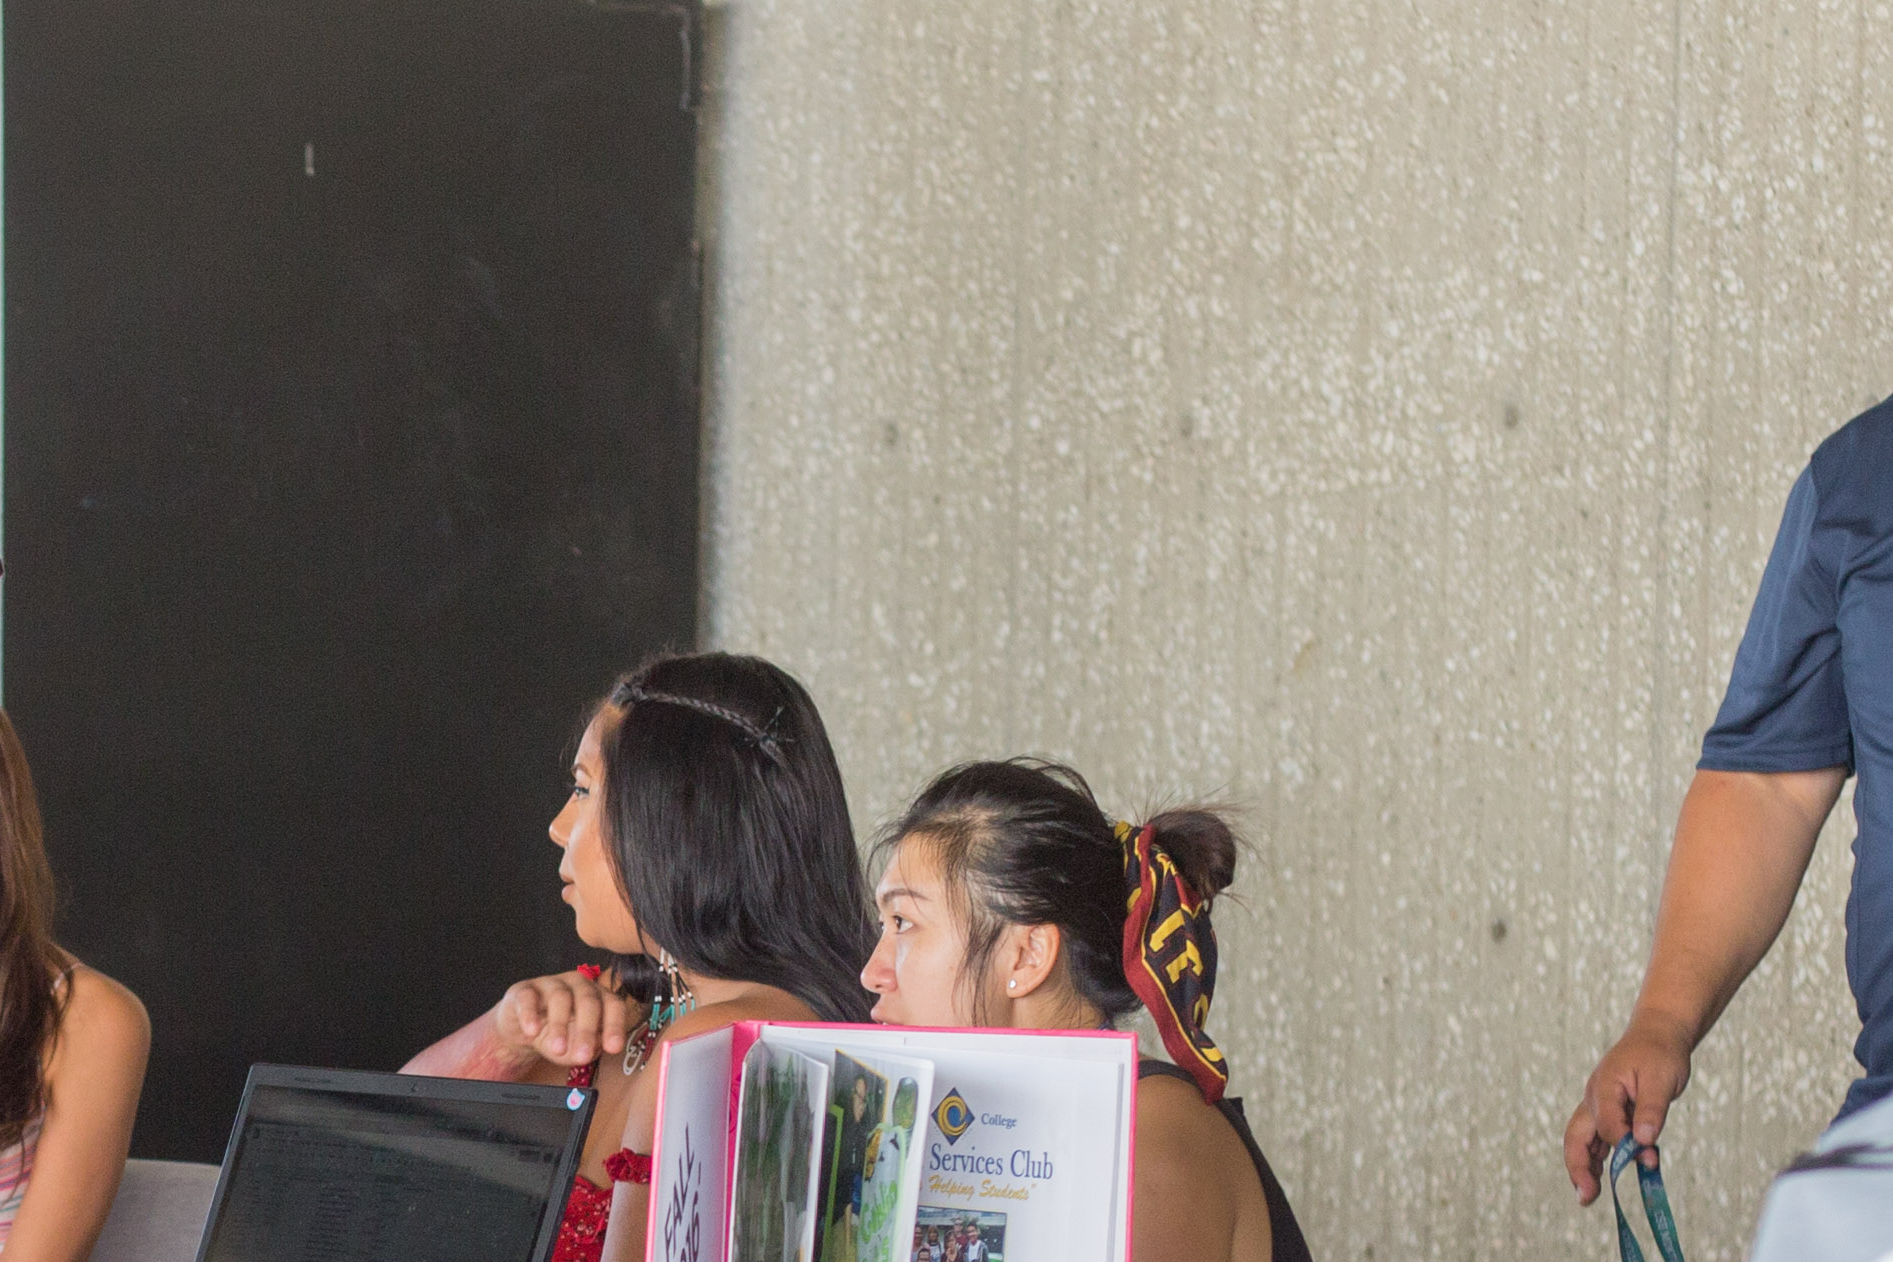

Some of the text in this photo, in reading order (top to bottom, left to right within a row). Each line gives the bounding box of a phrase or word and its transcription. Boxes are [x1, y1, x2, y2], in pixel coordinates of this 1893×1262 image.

[981, 1112, 1018, 1130] College
[929, 1142, 1054, 1180] Services Club
